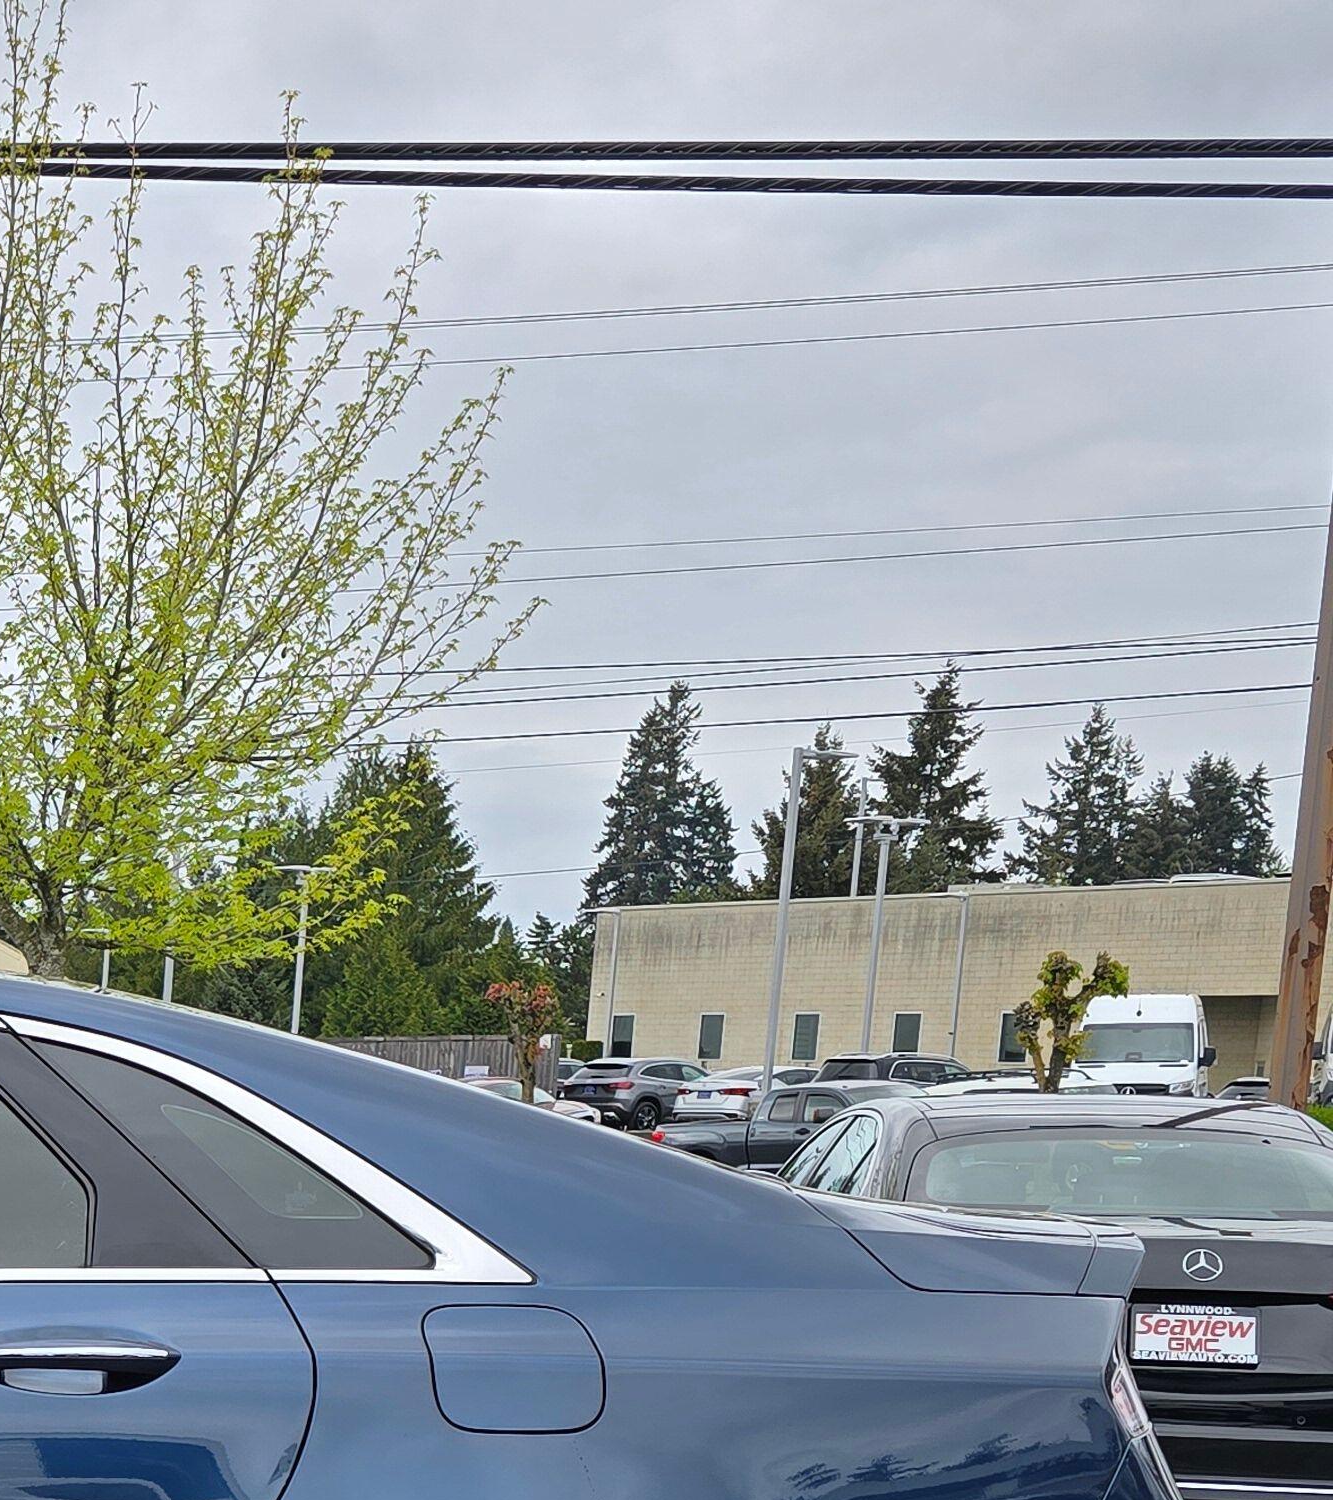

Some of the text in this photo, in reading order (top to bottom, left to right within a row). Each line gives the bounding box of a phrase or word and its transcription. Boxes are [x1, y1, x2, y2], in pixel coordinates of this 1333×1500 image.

[1161, 1304, 1232, 1315] LYNNWOOD
[1136, 1315, 1254, 1338] Seaview
[1168, 1337, 1221, 1352] GMC
[1132, 1350, 1258, 1364] SEAVIEWAUTO.COM
